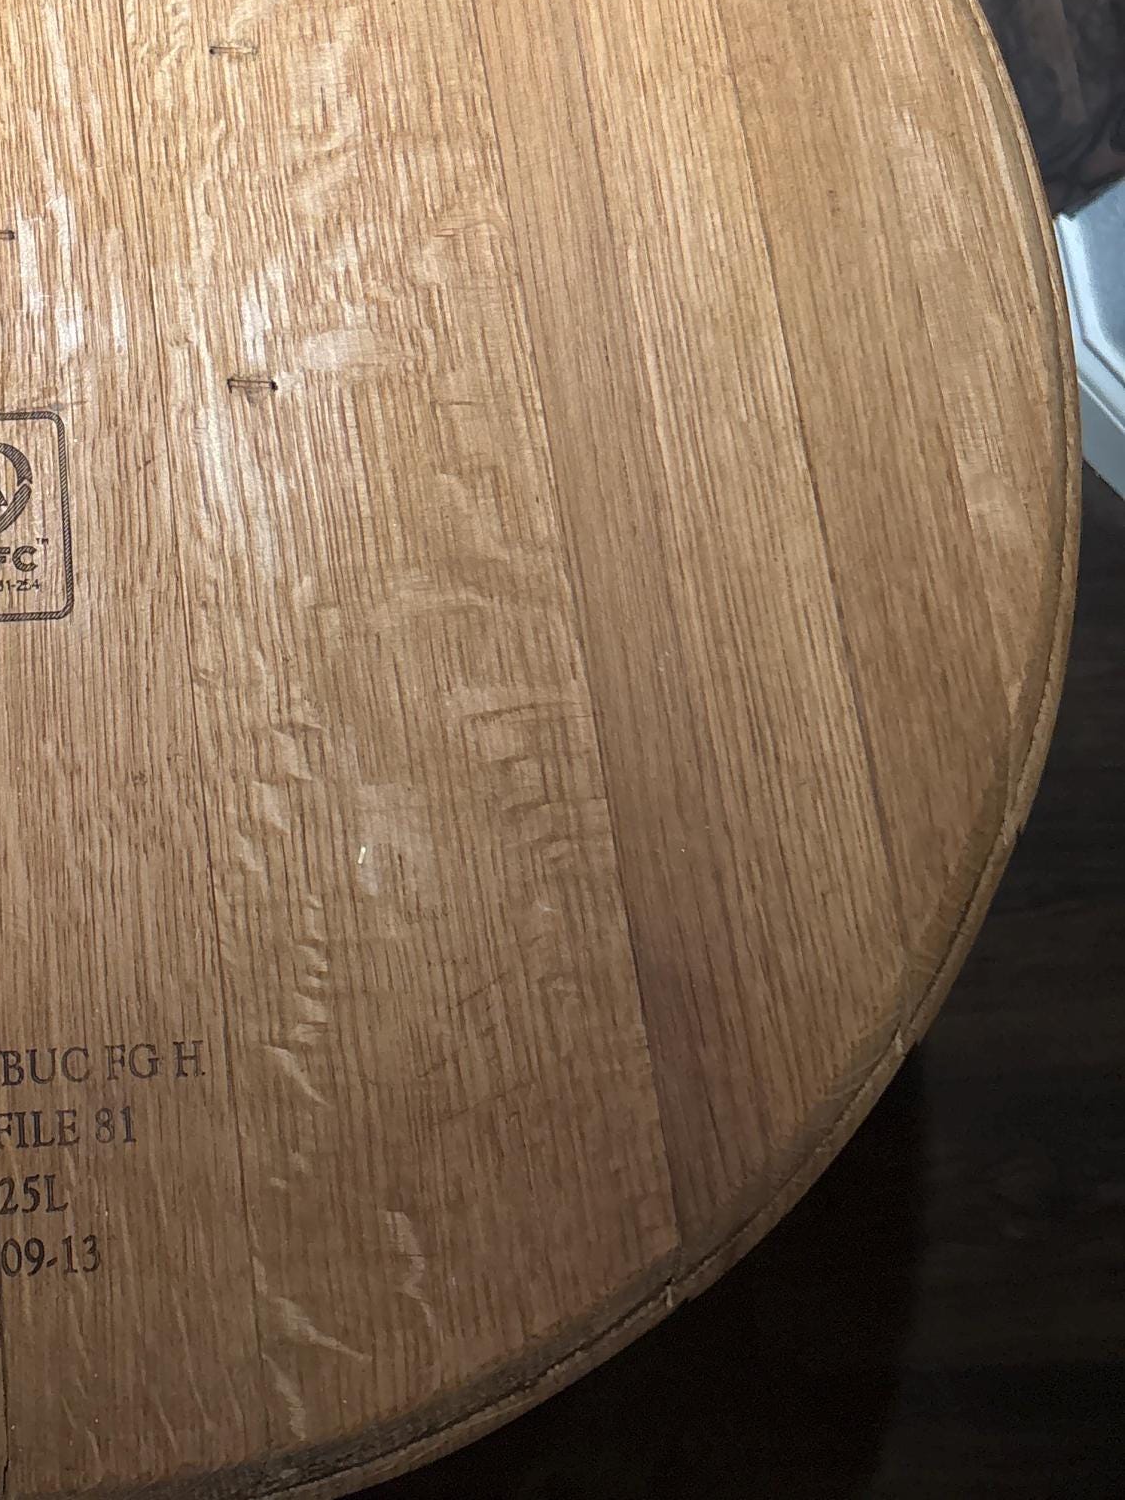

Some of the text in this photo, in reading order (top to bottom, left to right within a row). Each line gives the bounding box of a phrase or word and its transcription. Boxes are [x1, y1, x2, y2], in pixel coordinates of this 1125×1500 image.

[1, 1046, 90, 1087] BUC
[106, 1042, 159, 1081] FG
[94, 1105, 137, 1144] 81
